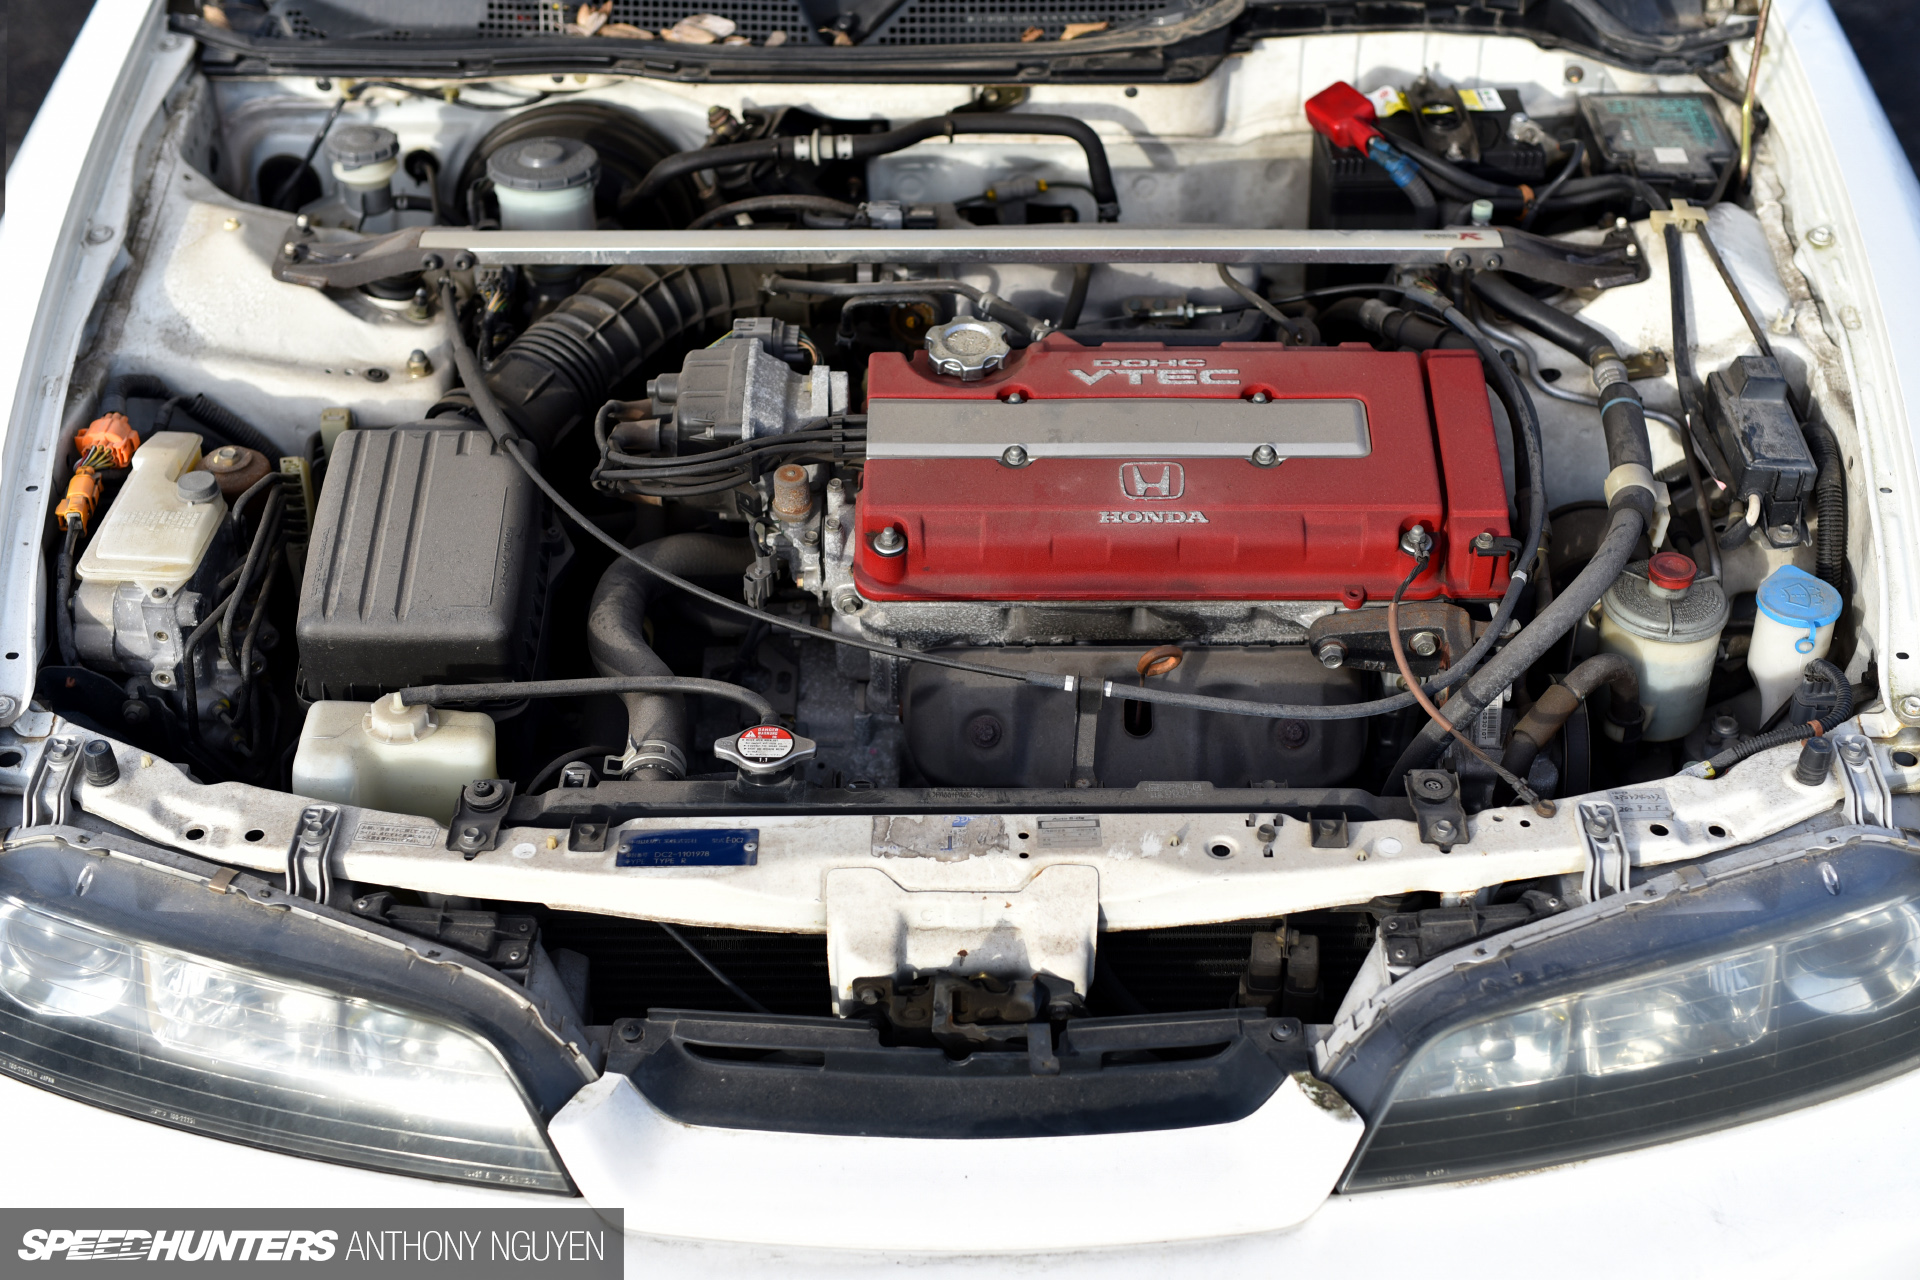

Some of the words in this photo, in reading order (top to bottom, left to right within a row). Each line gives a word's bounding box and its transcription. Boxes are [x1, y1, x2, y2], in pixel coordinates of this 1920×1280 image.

[1093, 359, 1206, 367] DOHC
[1068, 369, 1240, 386] VTEC
[1099, 511, 1210, 524] HONDA
